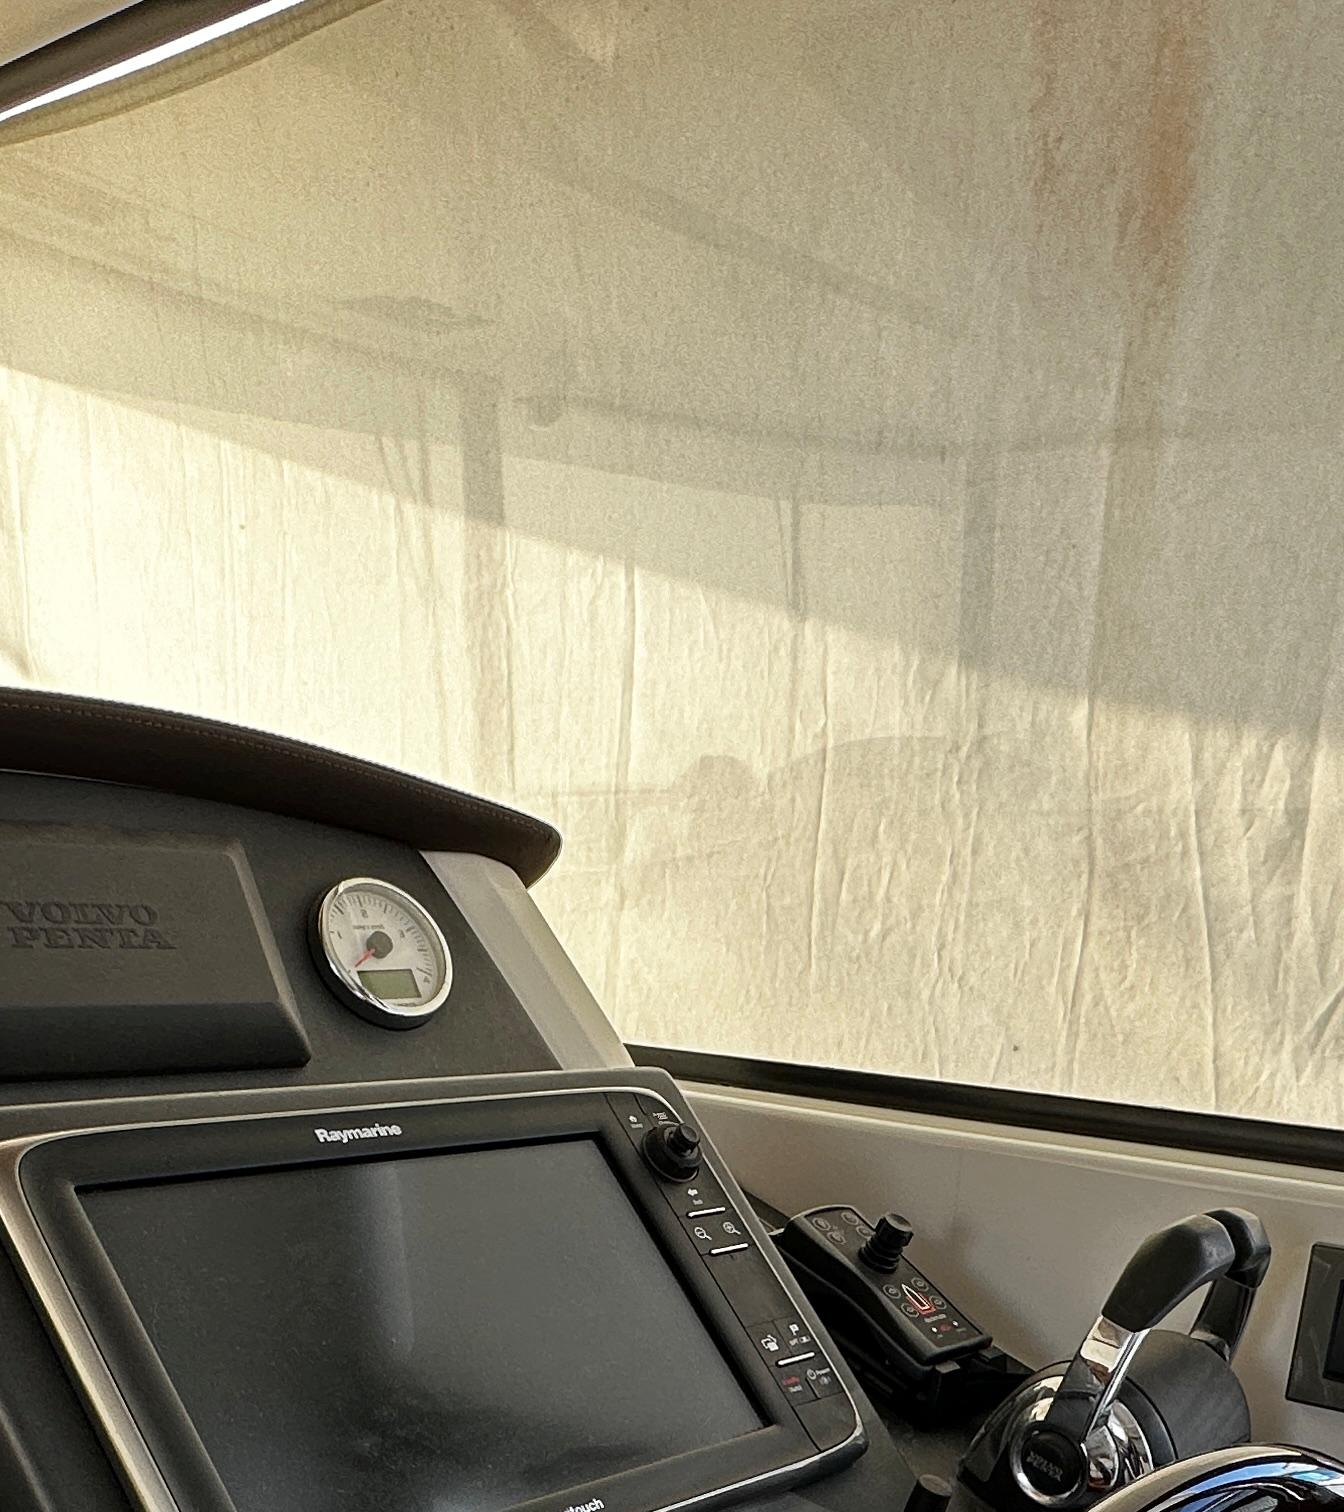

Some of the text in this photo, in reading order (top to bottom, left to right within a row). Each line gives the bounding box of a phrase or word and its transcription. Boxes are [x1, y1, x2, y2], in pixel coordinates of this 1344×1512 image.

[0, 901, 158, 926] VOLVO
[6, 926, 177, 950] PENTA
[314, 1122, 403, 1143] Raymarine
